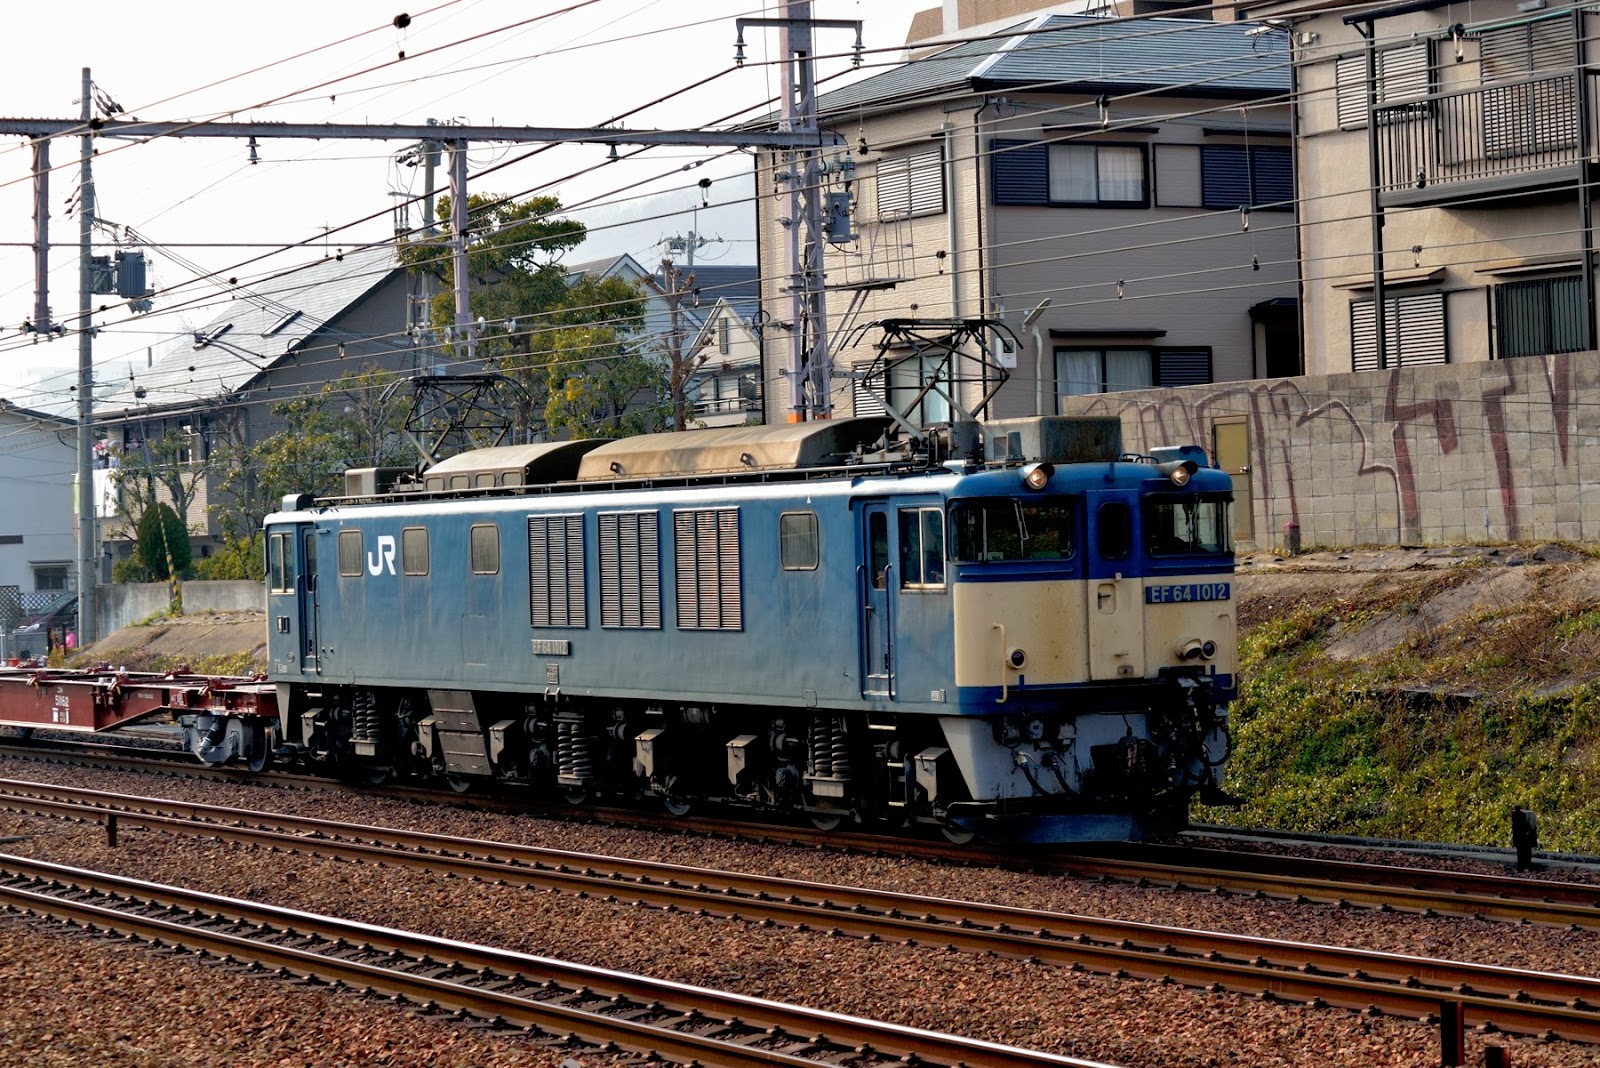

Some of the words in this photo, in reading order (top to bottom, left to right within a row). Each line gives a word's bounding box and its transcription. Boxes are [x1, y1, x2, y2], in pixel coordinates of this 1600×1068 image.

[368, 535, 396, 576] JR
[1151, 586, 1170, 603] EF
[1173, 585, 1192, 602] 64
[1196, 583, 1227, 601] 1012
[542, 641, 551, 655] 64
[552, 641, 567, 655] 1012
